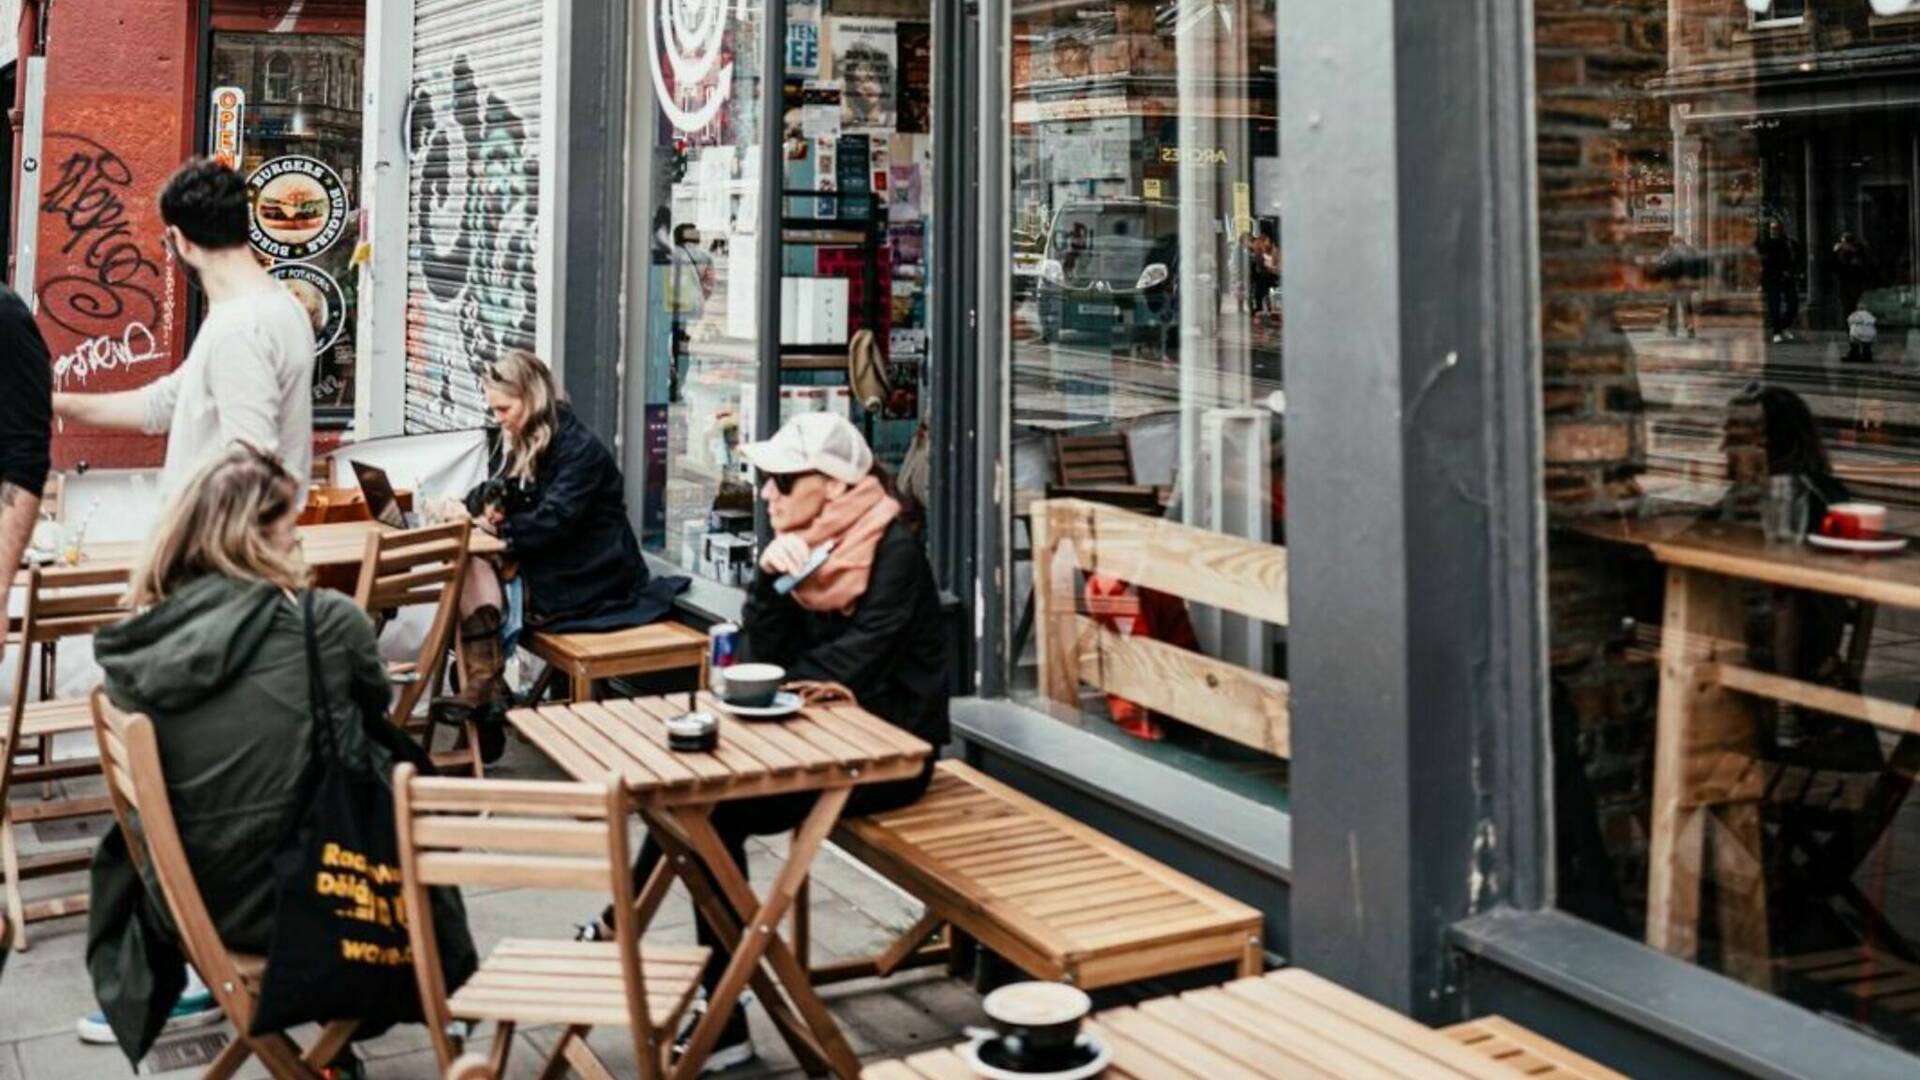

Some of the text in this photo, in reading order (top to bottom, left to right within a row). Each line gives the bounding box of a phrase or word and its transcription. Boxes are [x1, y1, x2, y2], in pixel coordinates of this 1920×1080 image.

[788, 40, 818, 67] EE
[216, 91, 238, 168] OPEN
[252, 160, 325, 188] BURGERS
[306, 186, 344, 253] BURGERS
